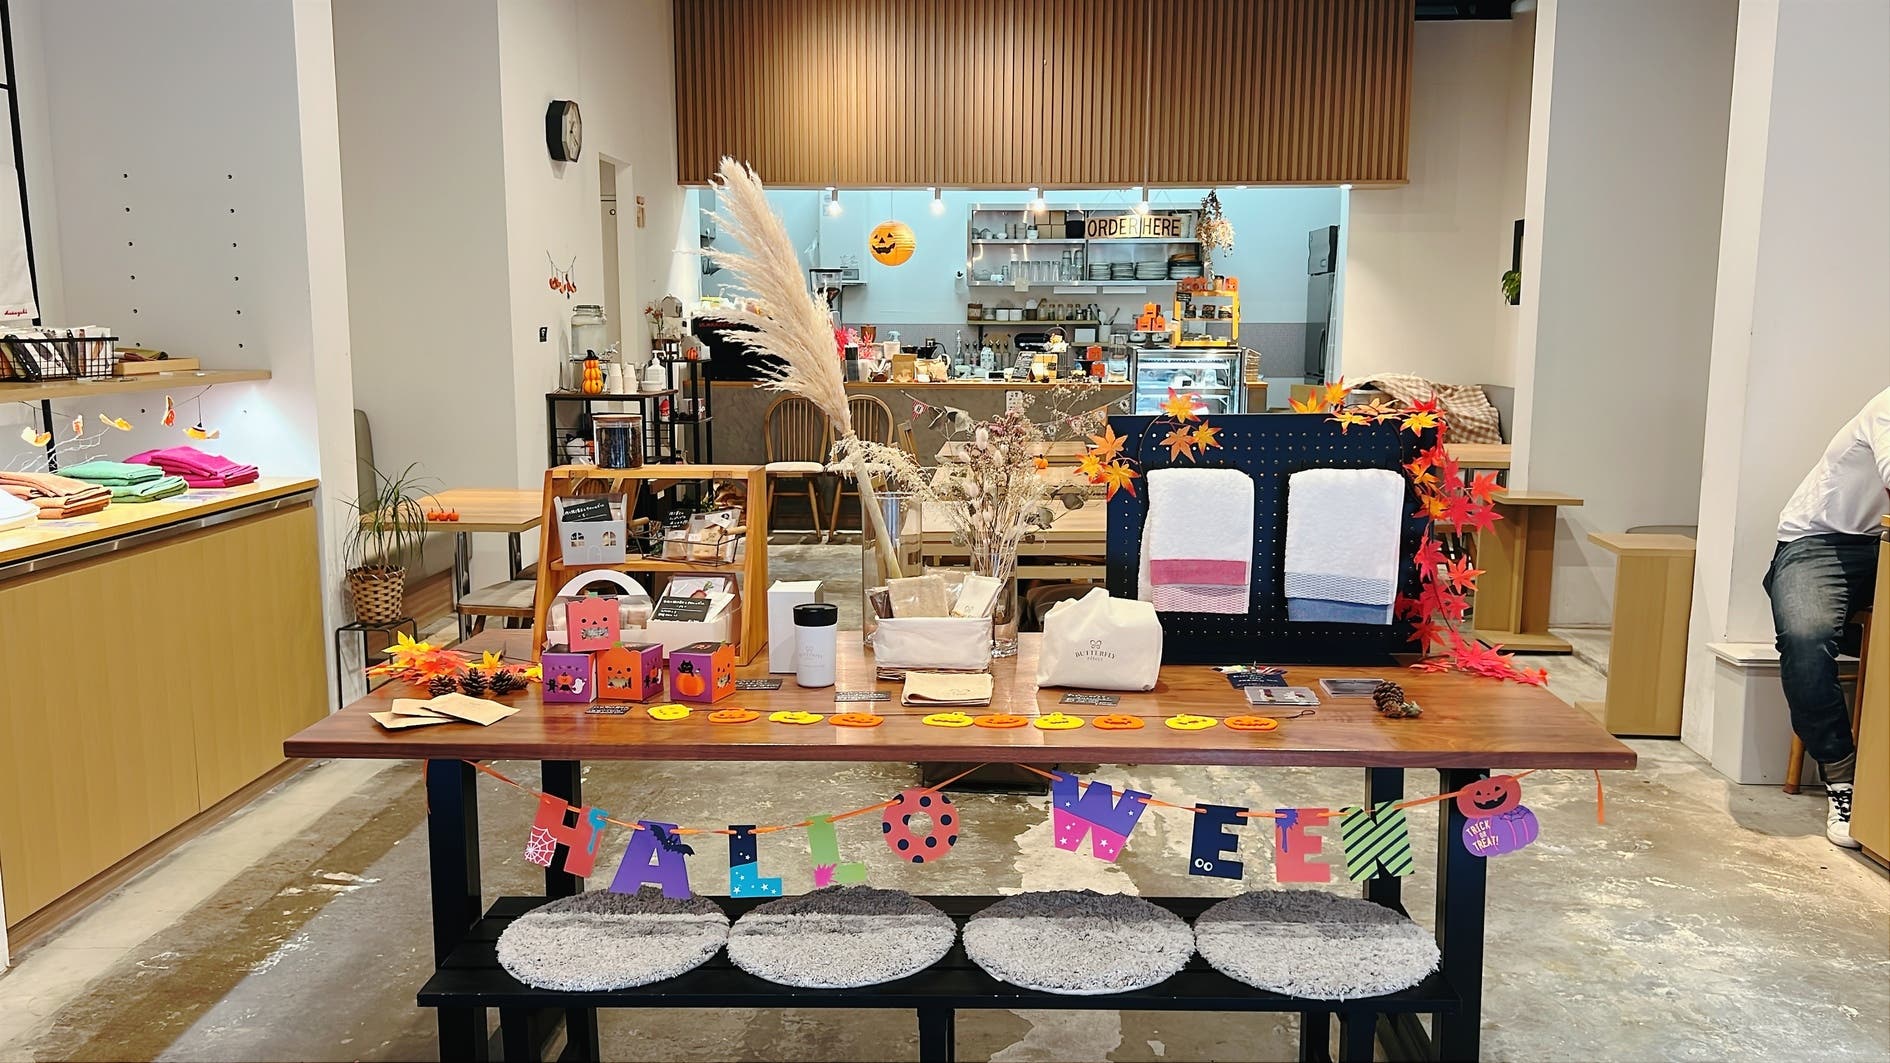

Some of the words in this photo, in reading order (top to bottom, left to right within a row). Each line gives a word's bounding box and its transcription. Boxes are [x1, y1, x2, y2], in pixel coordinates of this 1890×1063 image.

[1087, 219, 1139, 238] ORDER
[1142, 218, 1181, 237] HERE
[1466, 820, 1491, 836] TRICK
[1472, 835, 1499, 851] TREAT!
